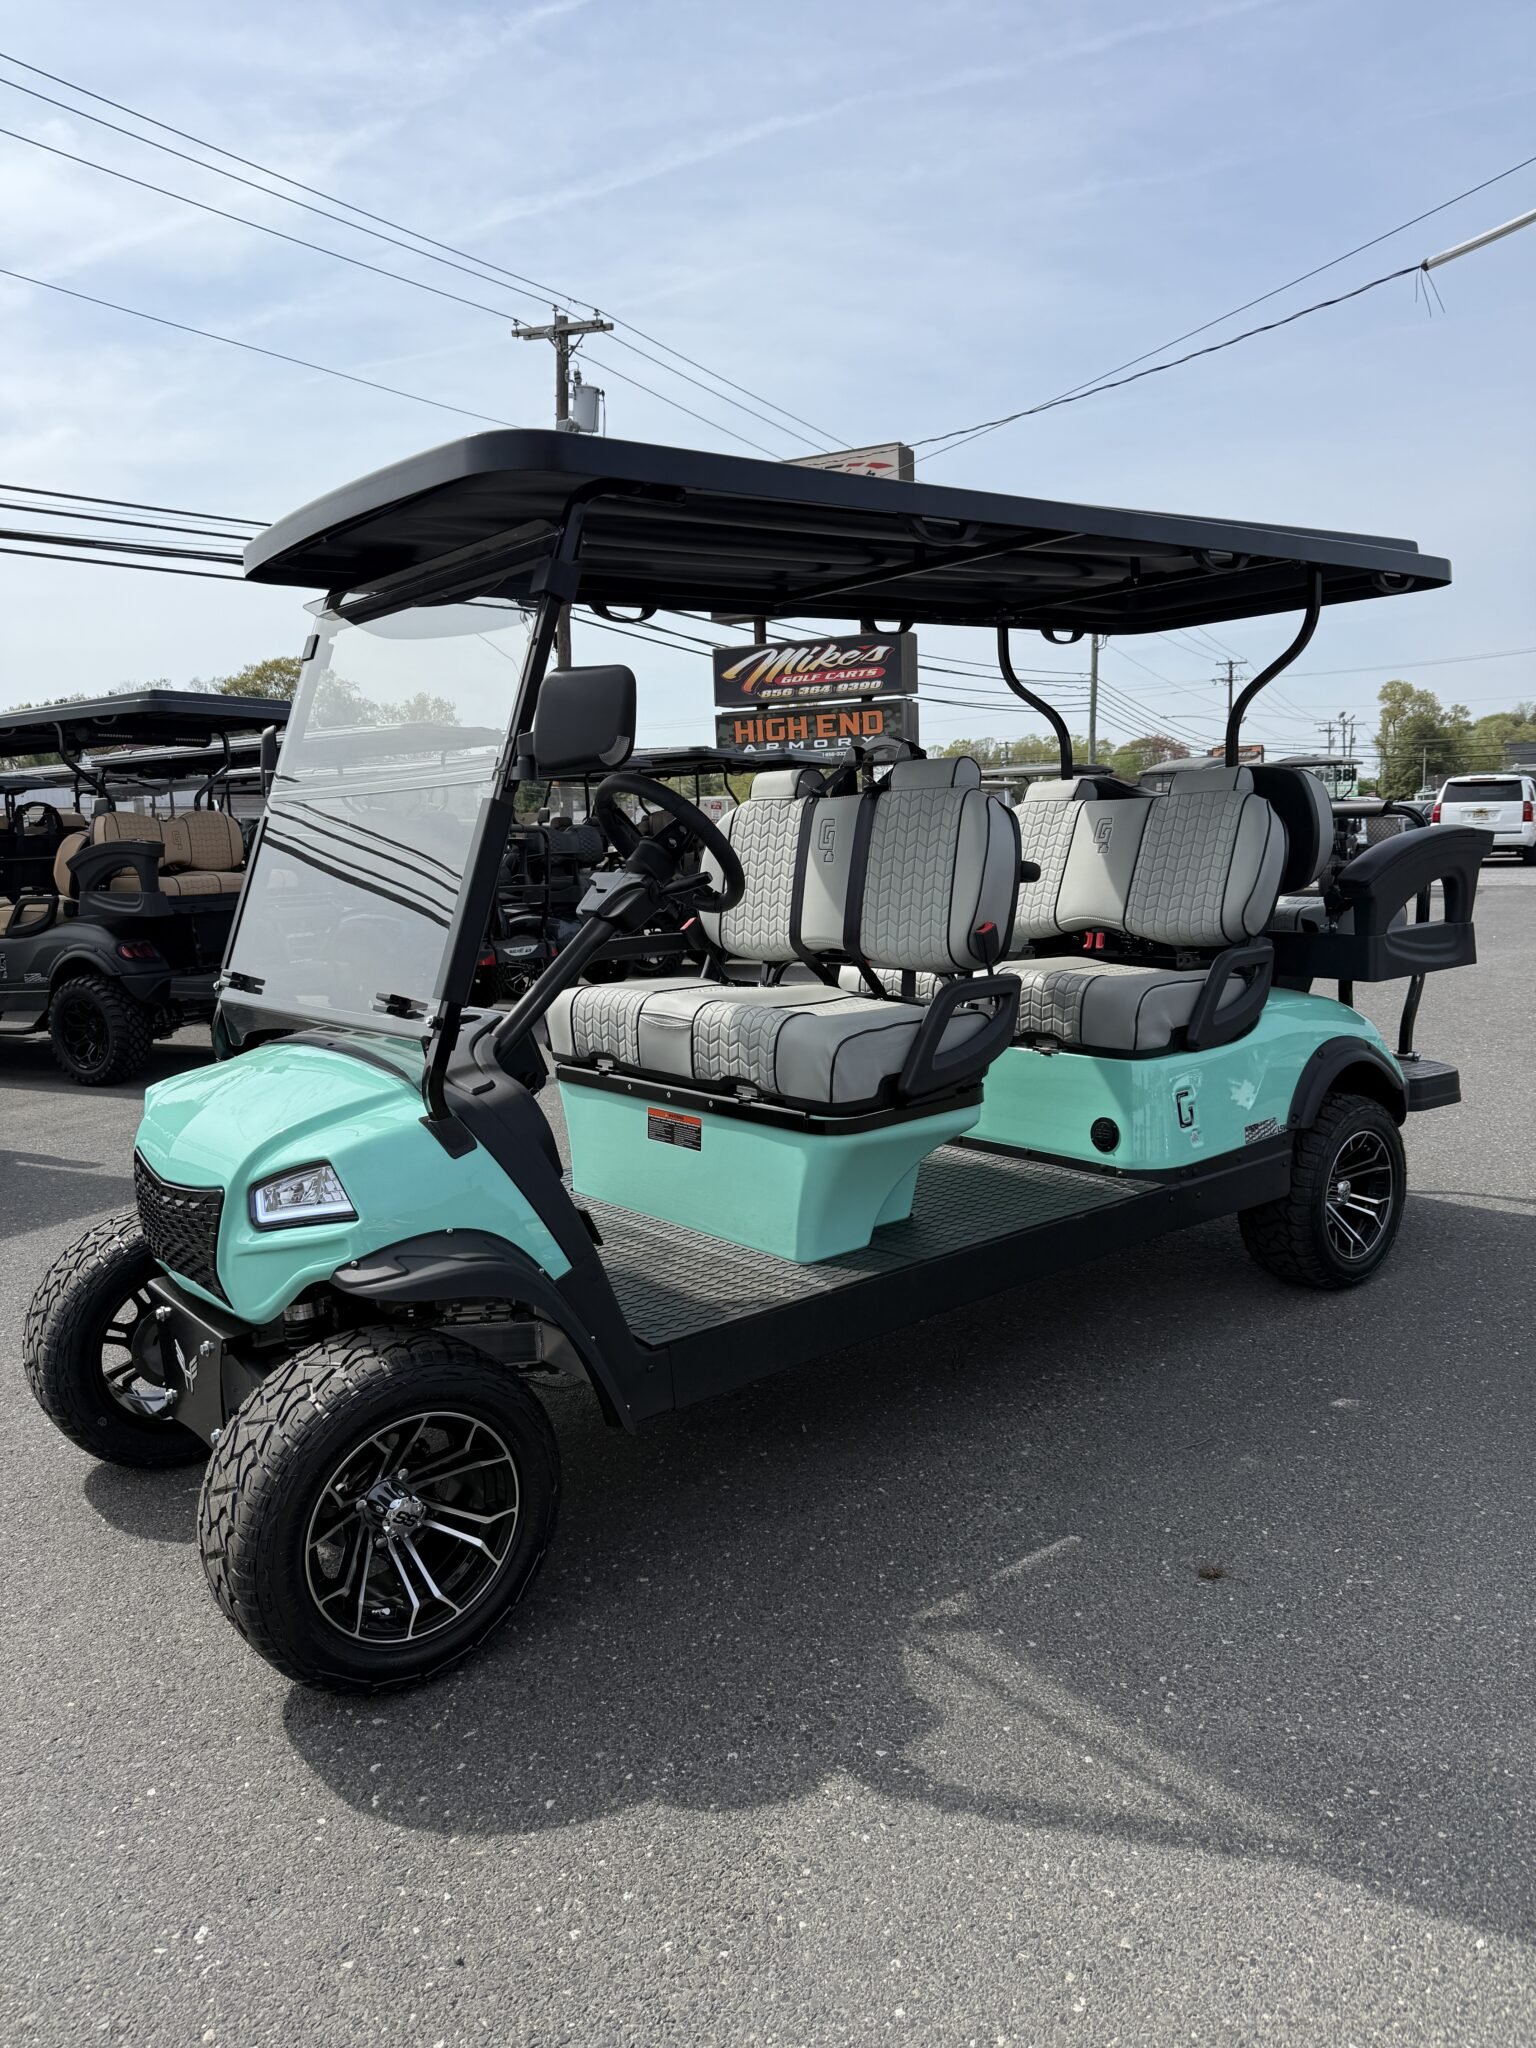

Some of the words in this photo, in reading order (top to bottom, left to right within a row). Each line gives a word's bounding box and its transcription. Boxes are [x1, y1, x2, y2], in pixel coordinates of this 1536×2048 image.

[721, 644, 893, 693] Mike's
[780, 673, 822, 684] GOLF
[825, 668, 878, 680] CARTS
[761, 688, 793, 698] 856
[799, 684, 831, 695] 364
[836, 680, 883, 692] 9390
[734, 715, 808, 744] HIGH
[816, 710, 884, 738] END
